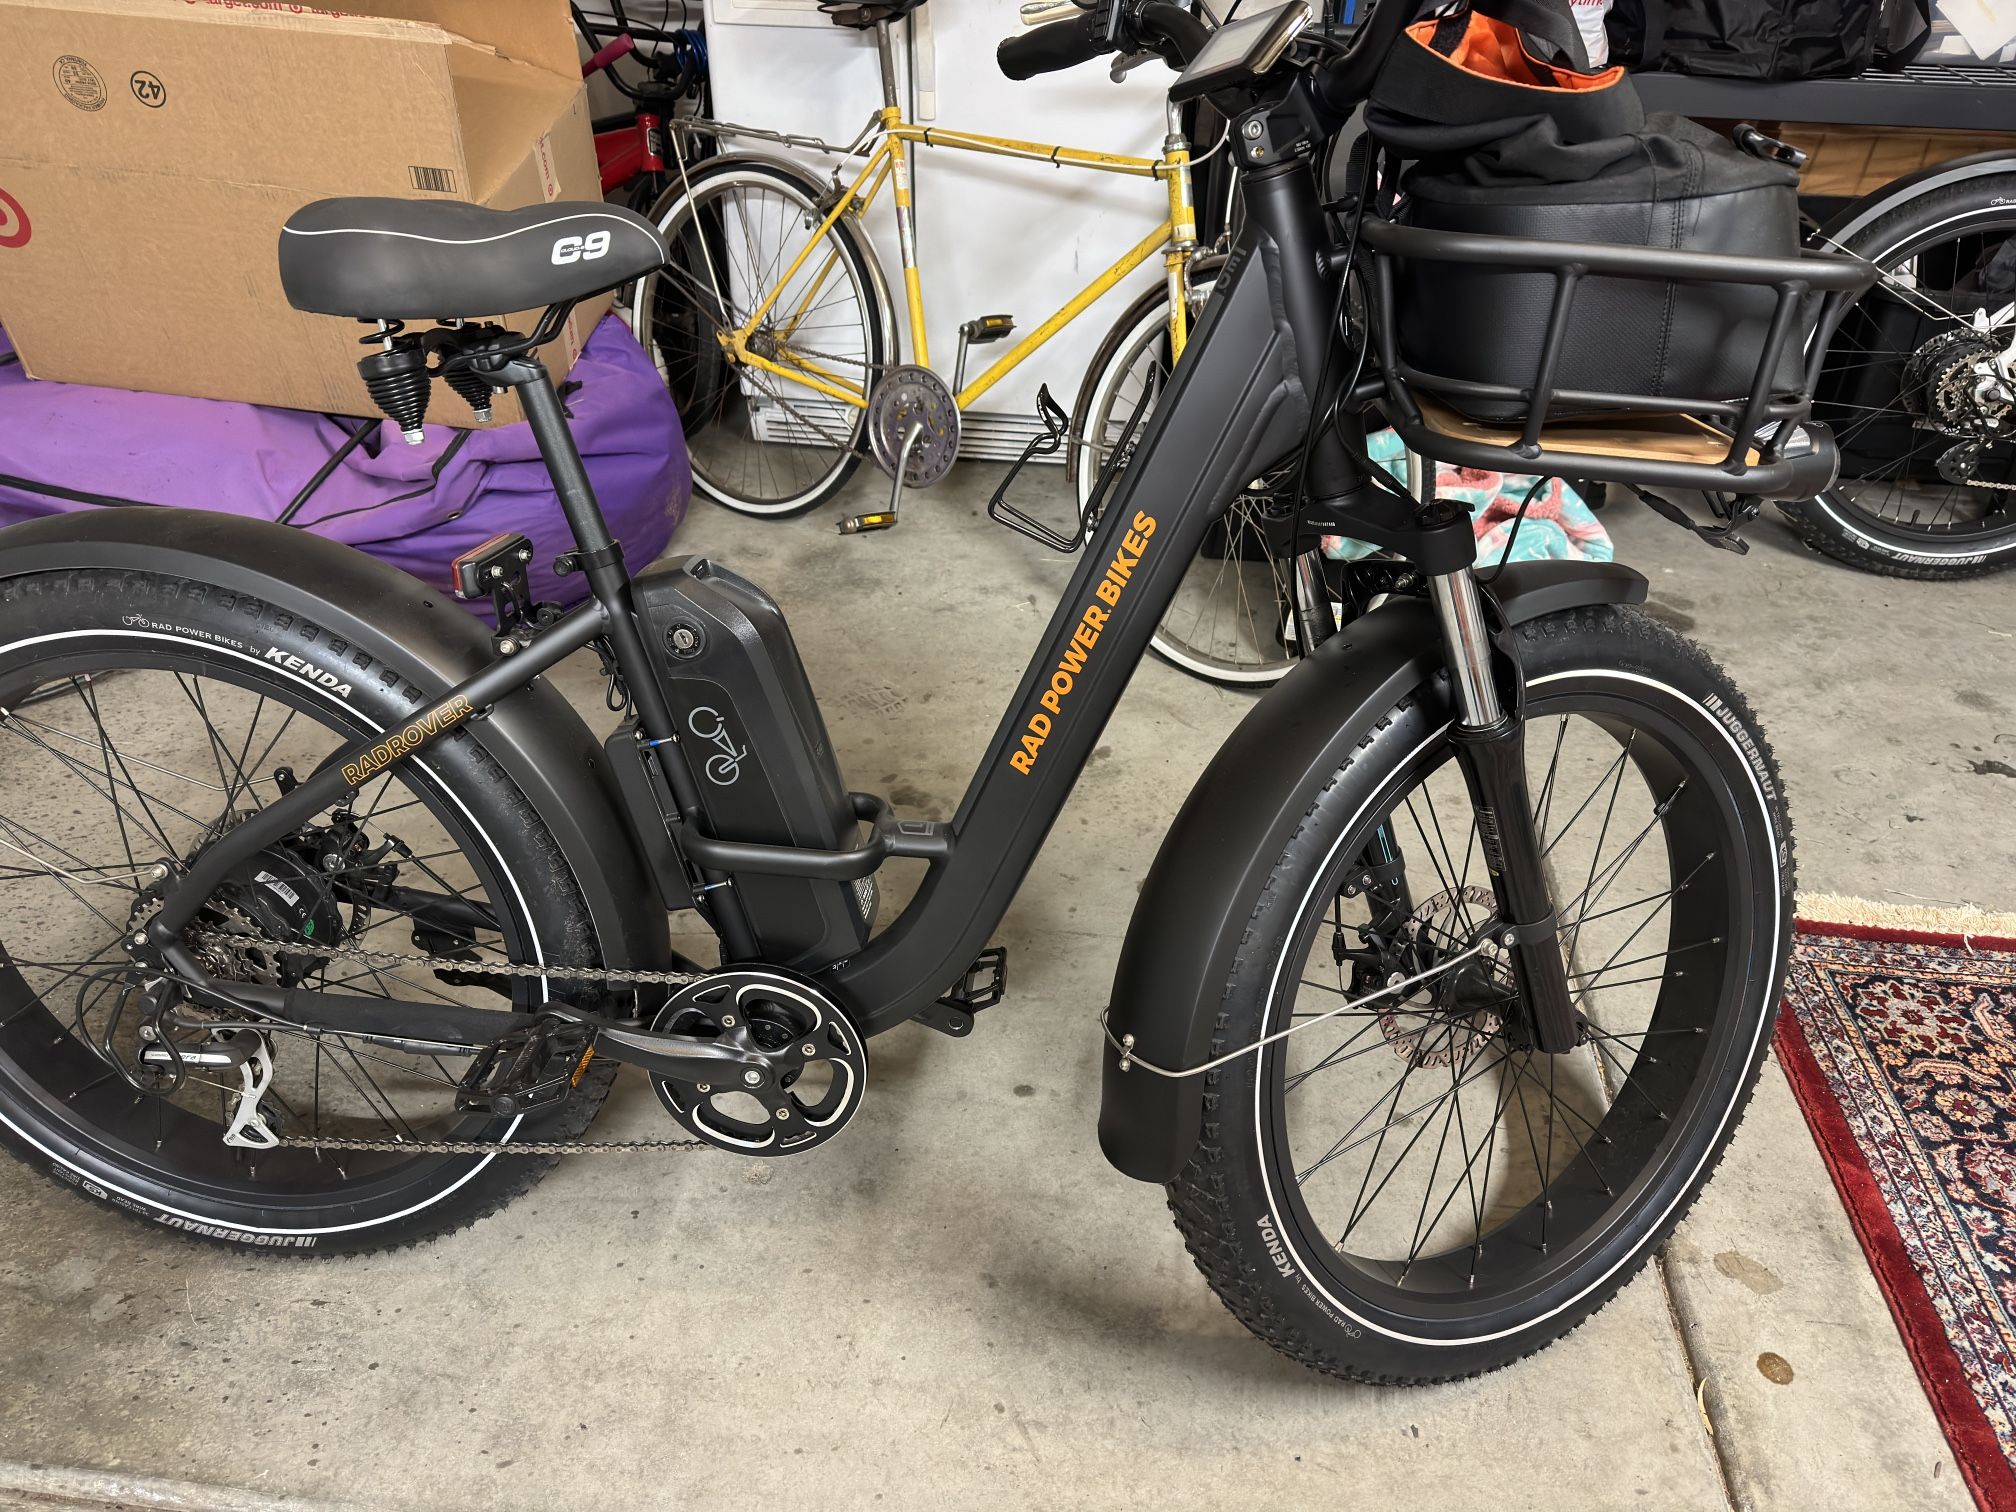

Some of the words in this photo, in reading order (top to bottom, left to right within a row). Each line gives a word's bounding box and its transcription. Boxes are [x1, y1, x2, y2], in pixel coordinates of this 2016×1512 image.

[134, 79, 161, 100] 42
[551, 230, 611, 265] C9
[1891, 552, 1972, 566] JUGGERNAUT
[151, 621, 172, 632] RAD
[175, 625, 212, 640] POWER
[214, 634, 244, 649] BIKES
[250, 645, 261, 656] by
[264, 646, 354, 699] KENDA
[1009, 712, 1052, 776] RAD
[1040, 604, 1110, 715] POWER
[1095, 510, 1157, 608] BIKES
[341, 694, 474, 786] RADROVER
[1715, 705, 1778, 801] JUGGERNAUT
[153, 1213, 296, 1247] JUGGERNAUT
[1256, 1213, 1296, 1279] KENDA
[1301, 1283, 1316, 1302] BIKES
[1315, 1299, 1335, 1320] POWER
[1333, 1316, 1346, 1328] RAD
